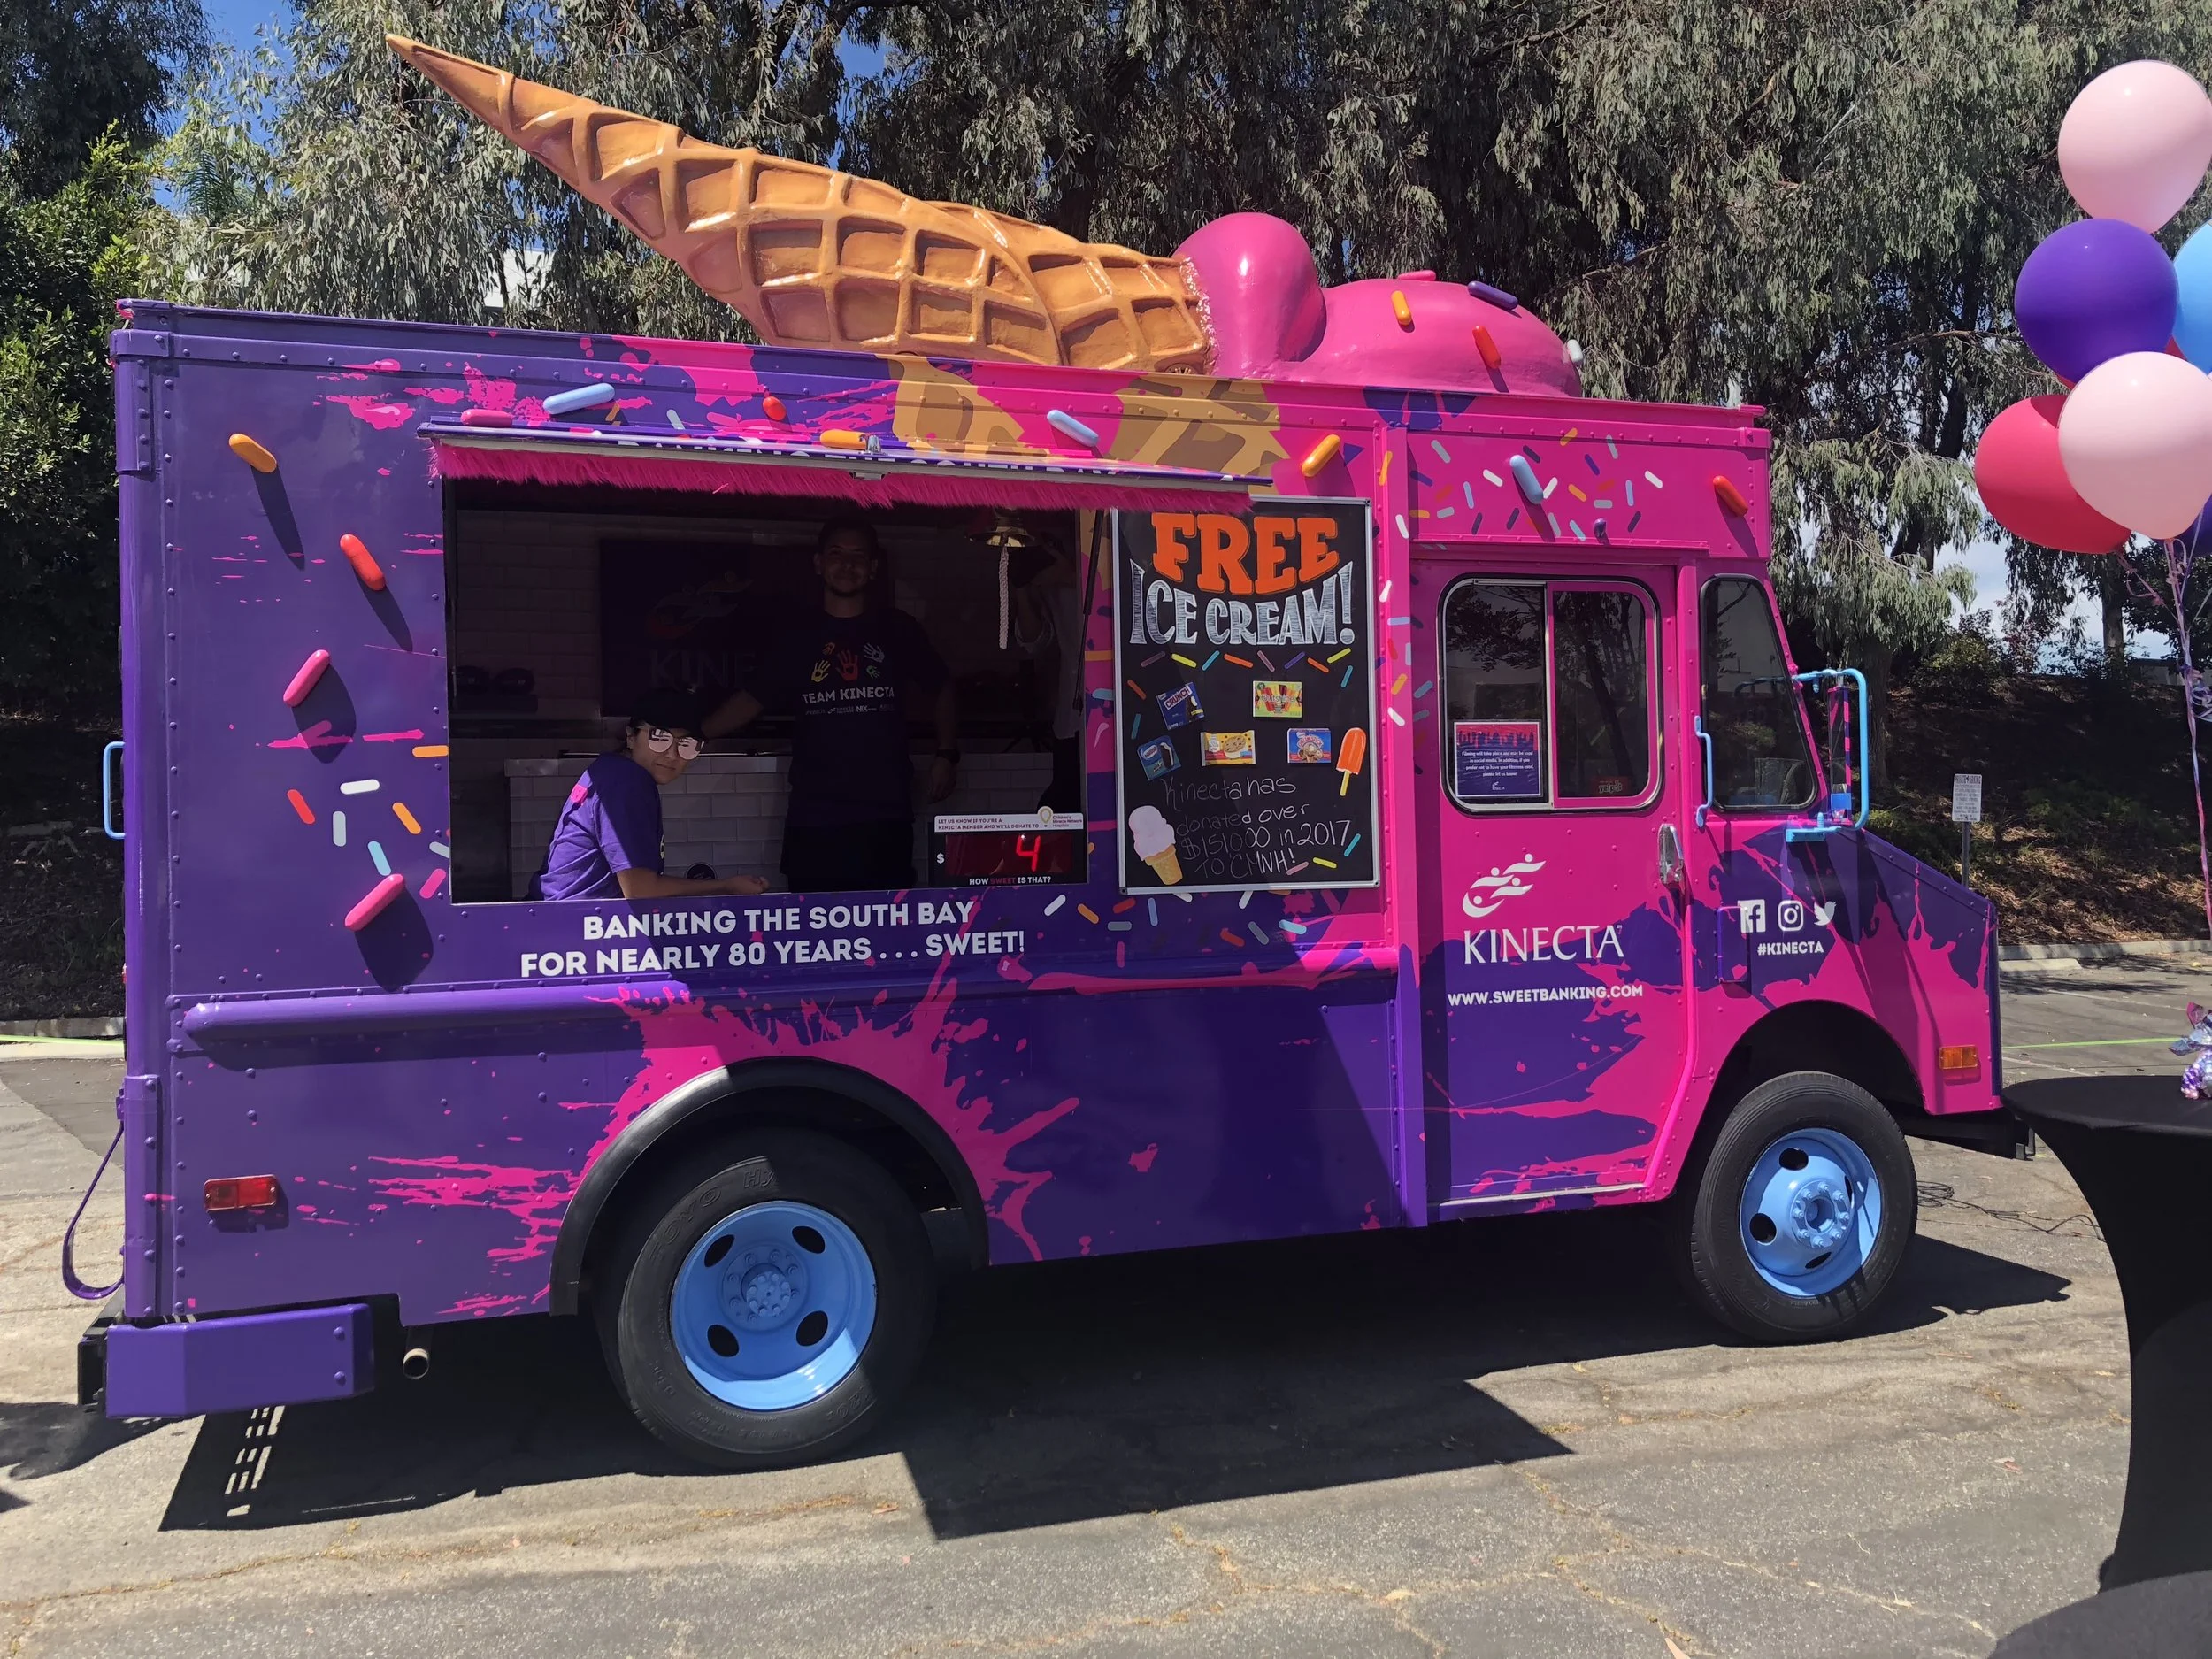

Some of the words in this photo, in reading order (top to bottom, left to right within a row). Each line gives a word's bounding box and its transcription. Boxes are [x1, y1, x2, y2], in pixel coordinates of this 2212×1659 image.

[1151, 512, 1339, 595] FREE
[1129, 558, 1198, 644] ICE
[1205, 561, 1356, 645] CREAM!
[802, 690, 836, 704] TEAM
[840, 687, 895, 700] KINECTA
[1165, 687, 1191, 707] CRUNCH
[1161, 777, 1242, 811] Kinecta
[1247, 776, 1296, 796] has
[1177, 809, 1251, 836] donated
[1258, 803, 1310, 824] over
[1279, 827, 1294, 846] in
[1297, 819, 1350, 847] 2017
[936, 853, 945, 864] $
[1016, 834, 1041, 872] 4
[1194, 858, 1225, 879] TO
[1230, 848, 1296, 879] CMNH!
[583, 910, 736, 940] BANKING
[744, 908, 801, 932] THE
[809, 903, 909, 929] SOUTH
[918, 901, 974, 925] BAY
[521, 951, 588, 978] FOR
[596, 944, 721, 973] NEARLY
[728, 942, 766, 967] 80
[773, 937, 872, 964] YEARS
[926, 931, 1025, 956] SWEET!
[1463, 925, 1624, 964] KINECTA
[1757, 941, 1824, 956] #KINECTA
[1448, 984, 1643, 1006] WWW.SWEETBANKING.COM
